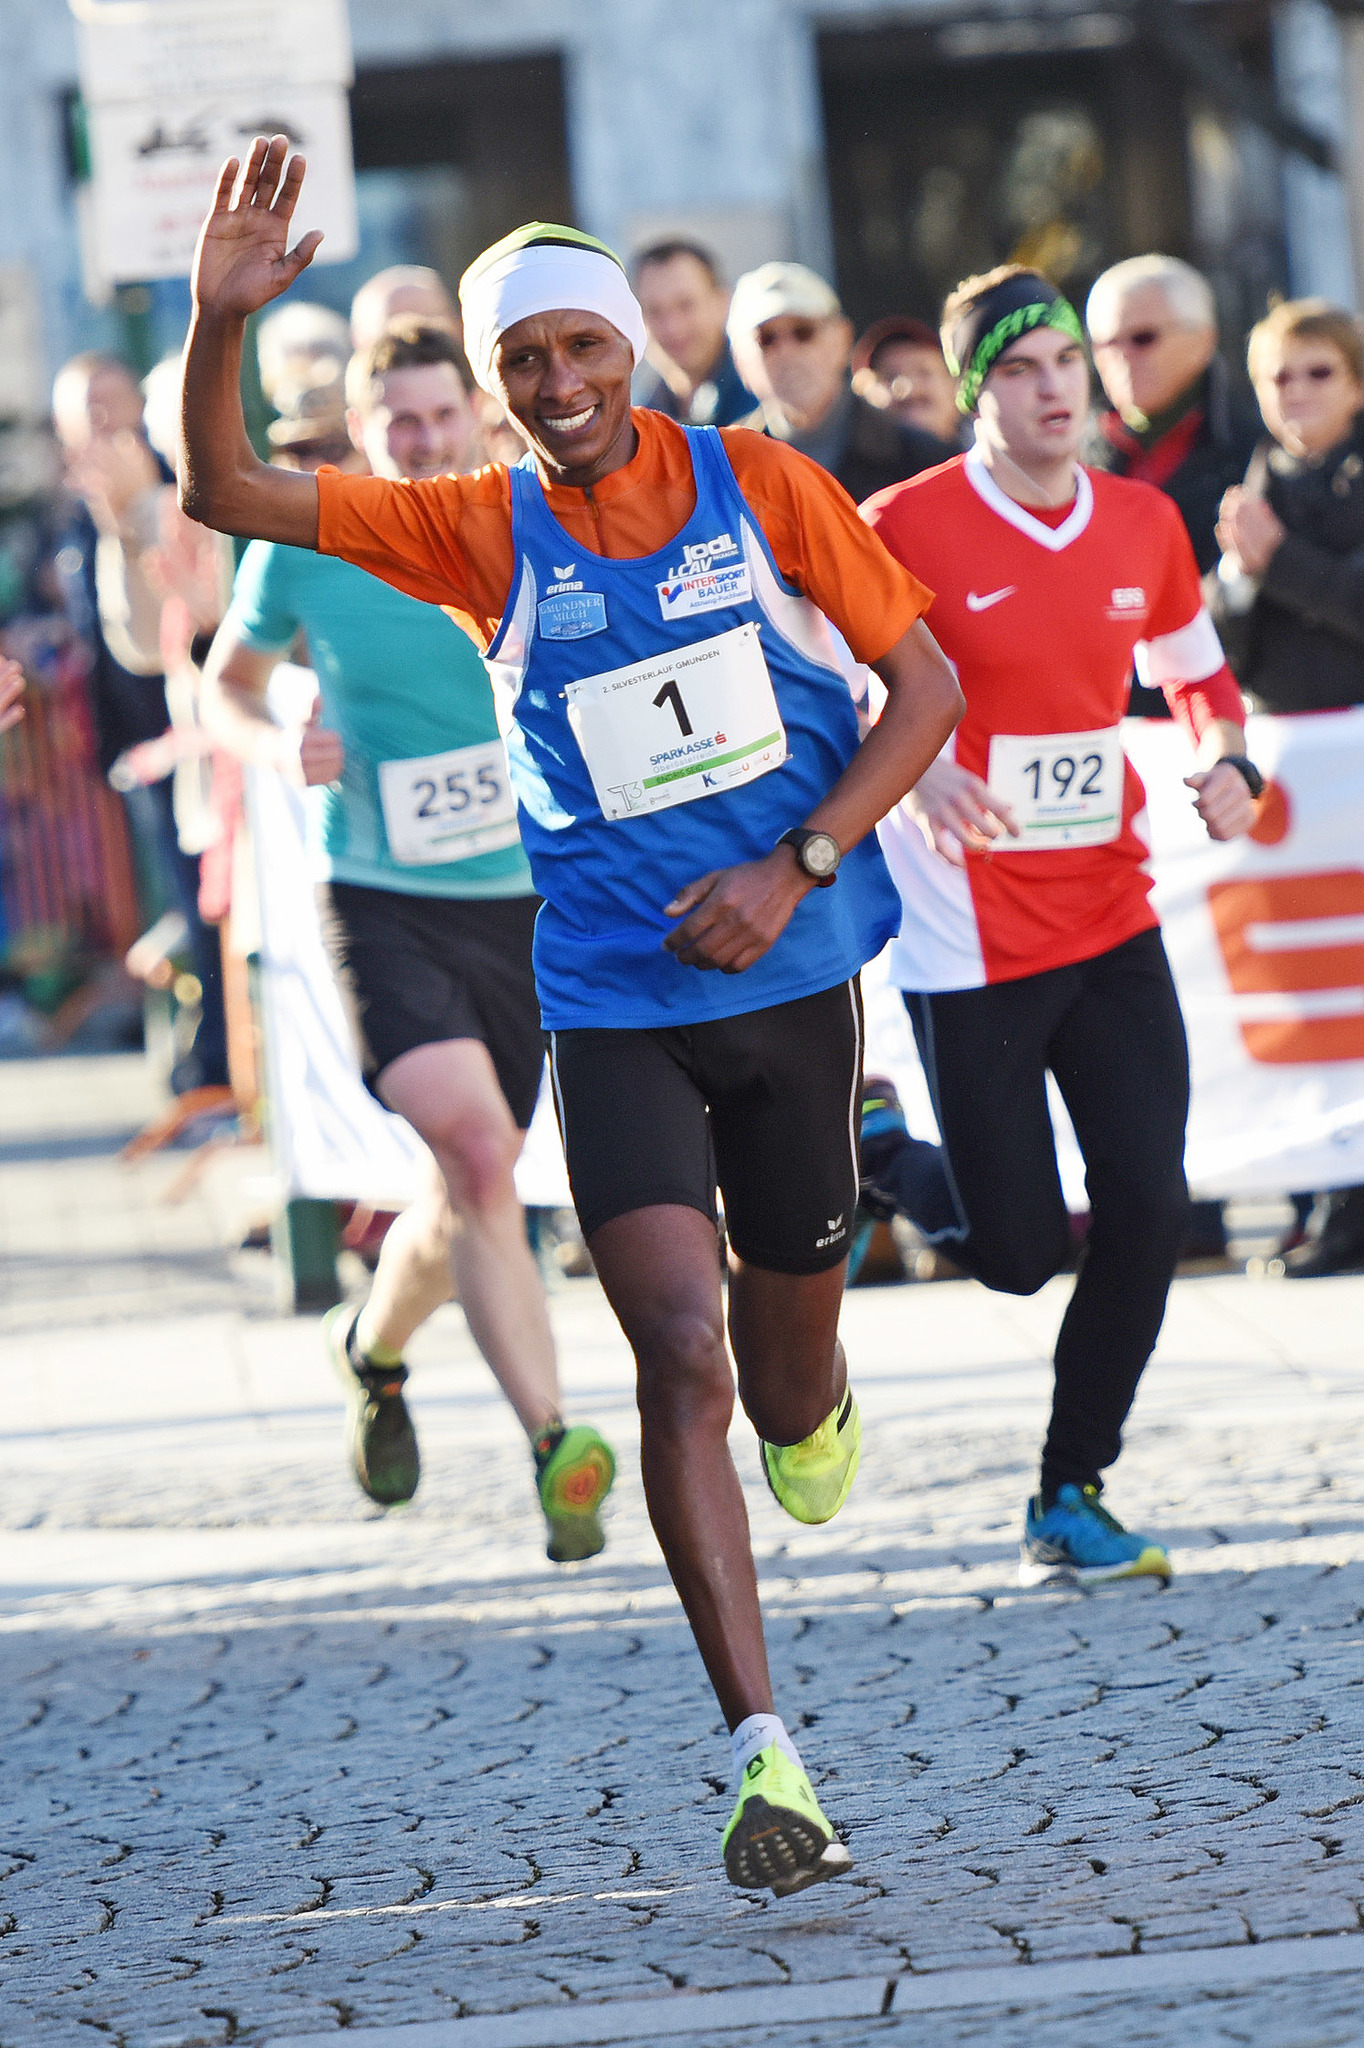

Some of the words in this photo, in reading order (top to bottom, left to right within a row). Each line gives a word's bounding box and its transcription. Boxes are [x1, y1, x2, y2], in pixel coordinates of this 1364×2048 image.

[668, 556, 713, 580] LCAV
[683, 568, 746, 591] INTERSPORT
[546, 581, 584, 595] erima
[697, 581, 739, 599] BAUER
[541, 598, 600, 614] GMUNDNER
[553, 609, 587, 621] MILCH
[602, 686, 611, 694] 2.
[611, 664, 674, 691] SILVESTERLAUF
[675, 649, 720, 669] GMUNDEN
[652, 679, 694, 737] 1
[649, 737, 715, 766] SPARKASSE
[1024, 754, 1103, 800] 192
[414, 764, 500, 818] 255
